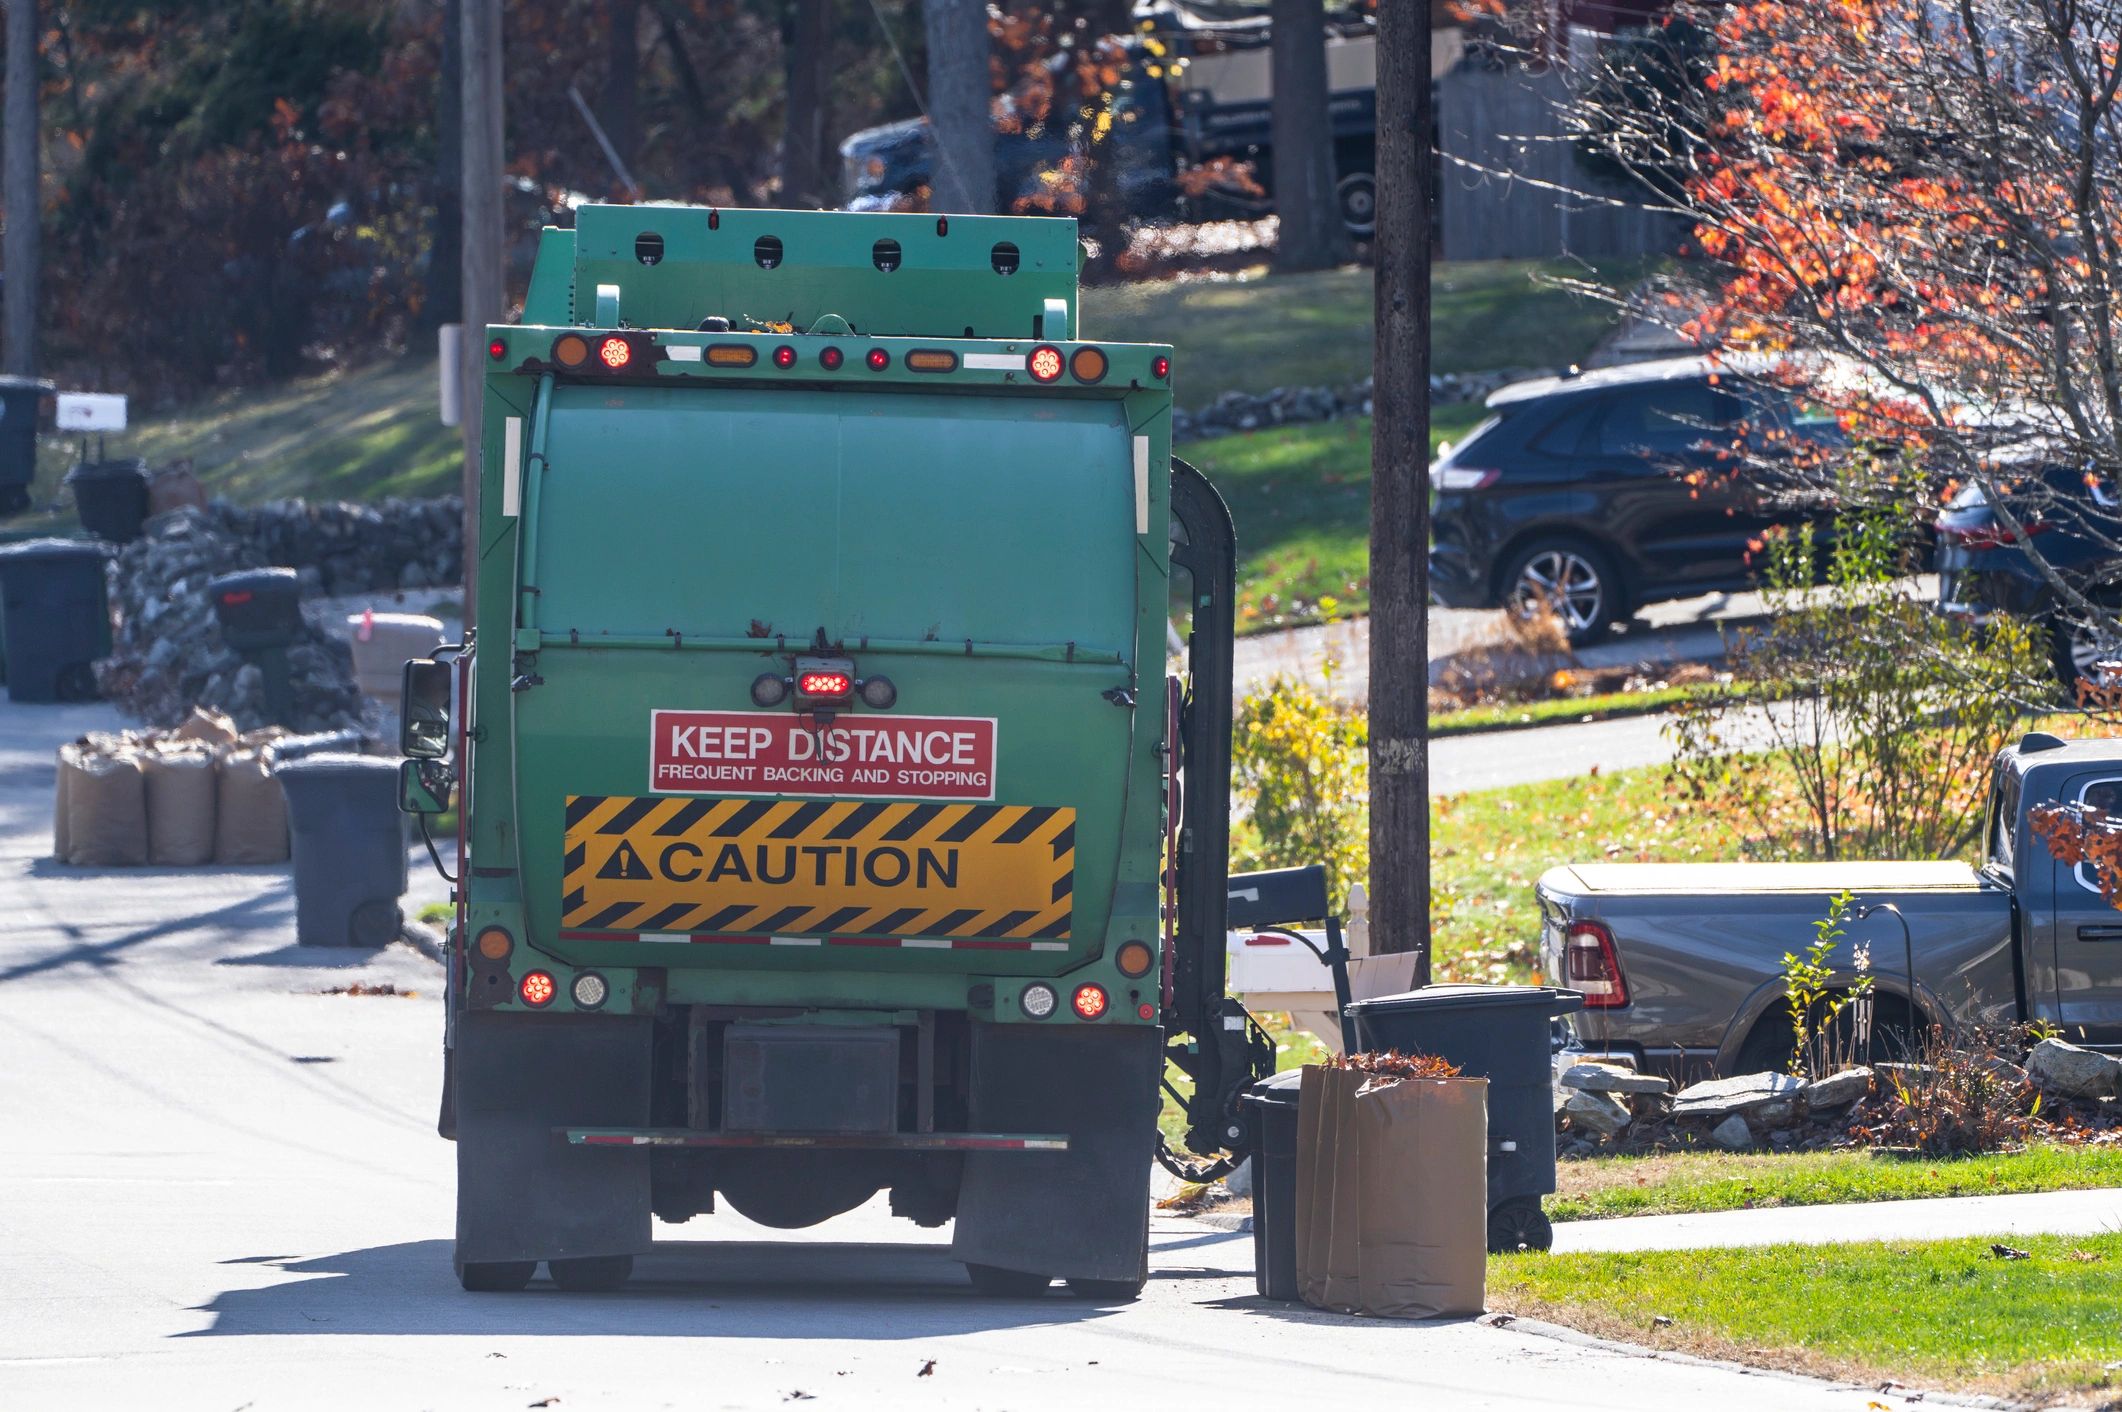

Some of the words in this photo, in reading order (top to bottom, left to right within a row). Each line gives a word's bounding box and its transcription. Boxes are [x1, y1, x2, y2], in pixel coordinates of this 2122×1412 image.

[671, 725, 773, 760] KEEP
[788, 728, 976, 765] DISTANCE
[658, 764, 757, 781] FREQUENT
[763, 767, 844, 782] BACKING
[851, 769, 890, 783] AND
[897, 770, 987, 786] STOPPING
[658, 841, 959, 888] CAUTION
